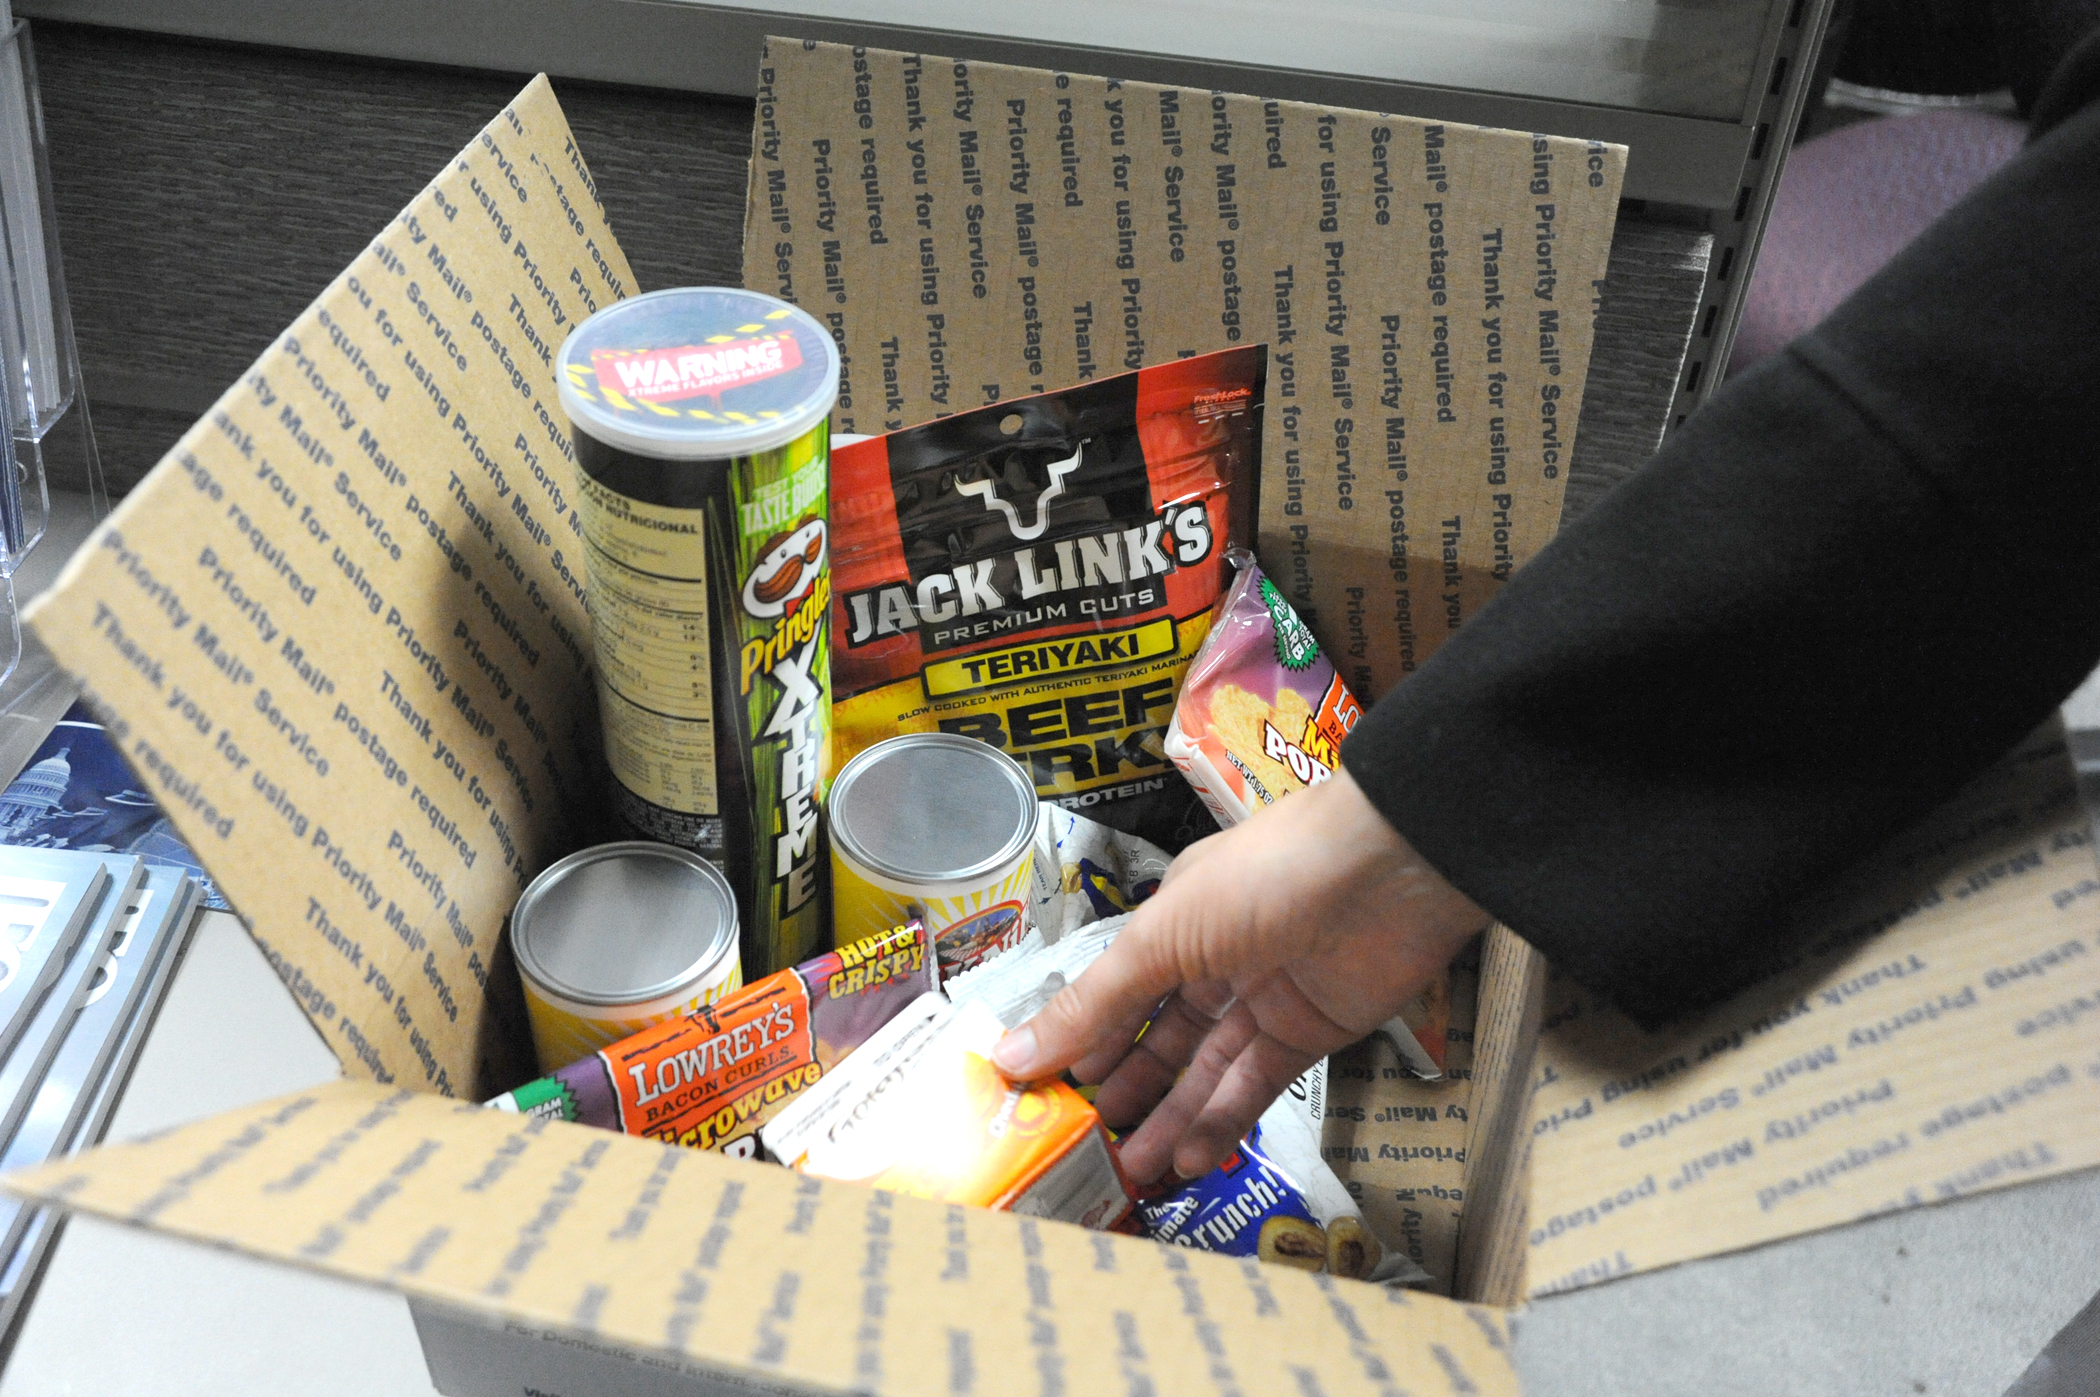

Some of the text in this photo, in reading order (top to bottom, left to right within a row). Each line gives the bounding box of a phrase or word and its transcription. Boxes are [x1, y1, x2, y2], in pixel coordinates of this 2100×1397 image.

[758, 68, 781, 162] Priority
[851, 45, 888, 244] ostage required
[1007, 100, 1030, 194] Priority
[1056, 98, 1083, 206] required
[1318, 114, 1337, 153] for
[1165, 166, 1187, 262] Service
[1319, 162, 1341, 232] using
[1371, 126, 1393, 225] Service
[471, 181, 566, 325] using Priority
[902, 54, 950, 404] Thank you for using Priority
[966, 205, 988, 298] Service
[1104, 99, 1144, 369] you for using Priority
[1424, 203, 1448, 305] postage
[1483, 228, 1504, 309] Thank
[1534, 204, 1556, 301] Priority
[813, 139, 835, 232] Priority
[826, 312, 854, 411] postage
[1217, 240, 1241, 341] postage
[1325, 242, 1347, 336] Priority
[407, 283, 466, 370] Service
[471, 314, 531, 397] postage
[614, 340, 783, 388] WARNING
[1018, 277, 1042, 375] postage
[1074, 302, 1096, 378] Thank
[1381, 315, 1402, 408] Priority
[1431, 316, 1456, 422] required
[1482, 318, 1501, 363] you
[283, 338, 356, 430] Priority
[375, 310, 510, 497] for using Priority
[629, 359, 784, 397] XTREME FLAVORS INSIDE
[881, 337, 903, 411] Thank
[1275, 265, 1305, 516] Thank you for using
[1488, 372, 1507, 408] for
[515, 436, 567, 513] Priority
[1335, 419, 1355, 510] Service
[1488, 417, 1509, 485] using
[1541, 385, 1561, 479] Service
[335, 473, 401, 560] Service
[407, 497, 472, 585] postage
[449, 474, 550, 613] Thank you for
[743, 489, 790, 534] TASTE
[1385, 490, 1411, 582] postage
[1441, 516, 1464, 587] Thank
[199, 549, 278, 643] Priority
[228, 506, 317, 605] required
[257, 462, 453, 693] you for using Priority
[849, 505, 1212, 645] JACK LINK'S
[934, 588, 1154, 645] PREMIUM CUTS
[961, 632, 1140, 685] TERIYAKI
[1274, 605, 1305, 661] CARB
[897, 651, 1201, 721] SLOW COOKED WITH AUTHENTIC TERIYAKI MARINA
[938, 676, 1174, 748] BEEF
[254, 690, 329, 776] Service
[382, 672, 491, 809] Thank you for
[1264, 719, 1332, 786] POR
[167, 690, 382, 910] you for using Priority
[334, 704, 477, 868] postage required
[388, 832, 445, 902] Priority
[307, 898, 442, 1081] Thank you for using
[423, 952, 457, 1022] Service
[827, 942, 928, 1001] CRISPY
[629, 1001, 795, 1107] LOWREY'S
[1848, 986, 1978, 1049] Priority
[645, 1077, 721, 1124] BACON
[1310, 1066, 1324, 1121] CRUNCHY
[1620, 1089, 1739, 1147] Service
[1765, 1079, 1895, 1144] Priority
[1379, 1144, 1467, 1163] Priority
[1145, 1203, 1170, 1221] The
[1152, 1195, 1200, 1244] imate
[1526, 1175, 1657, 1247] postage
